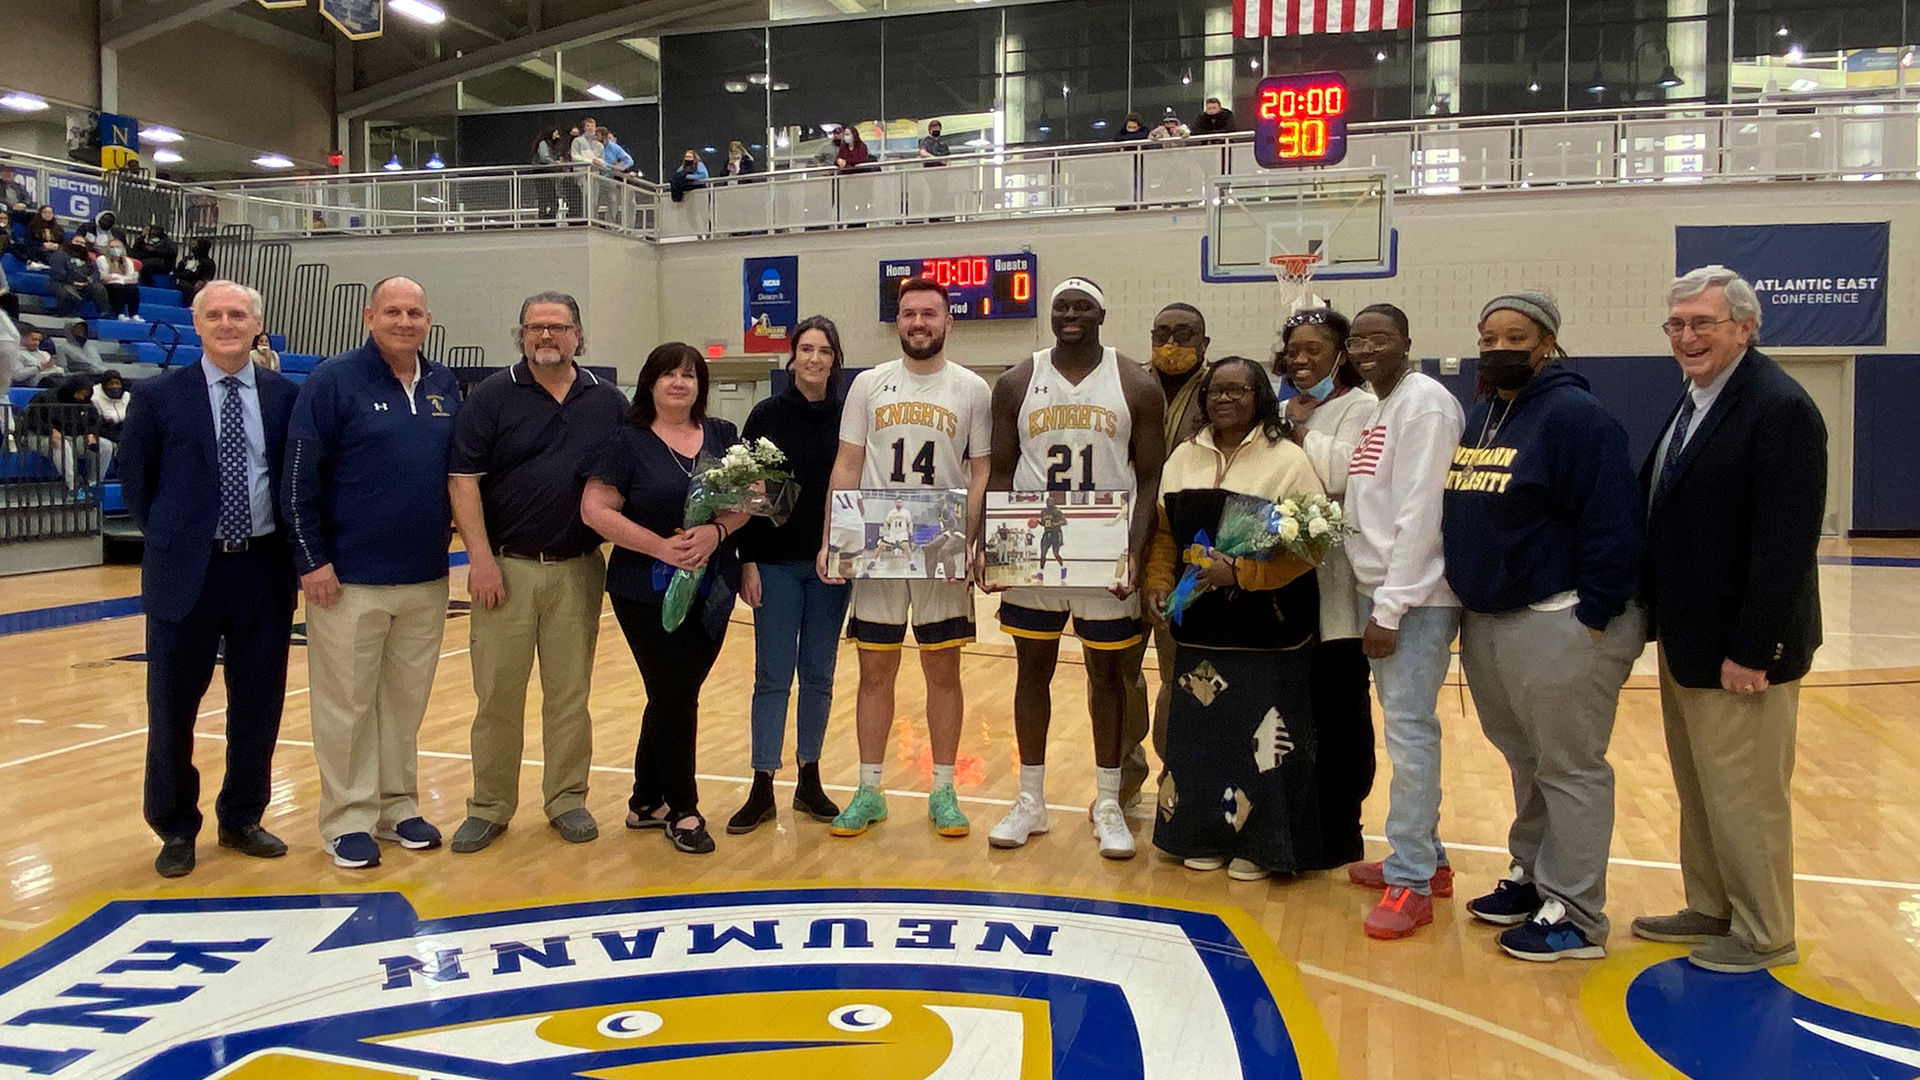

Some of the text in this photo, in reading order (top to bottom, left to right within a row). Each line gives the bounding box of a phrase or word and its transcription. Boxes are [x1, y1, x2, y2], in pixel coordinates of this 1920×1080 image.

[1261, 87, 1342, 119] 20:00
[112, 124, 129, 145] N
[1279, 120, 1325, 158] 30
[113, 149, 128, 169] U
[69, 195, 90, 217] G
[885, 264, 911, 277] Home
[921, 258, 988, 287] 20:00
[994, 259, 1027, 271] Guests
[1013, 272, 1030, 301] 0
[1754, 277, 1878, 291] ATLANTIC EAST
[1771, 292, 1859, 305] CONFERENCE
[949, 297, 990, 316] riod 1
[875, 401, 958, 439] KNIGHTS
[1028, 404, 1118, 439] KNIGHTS
[890, 437, 936, 486] 14
[1046, 444, 1096, 491] 21
[378, 916, 1060, 991] NEUMANN
